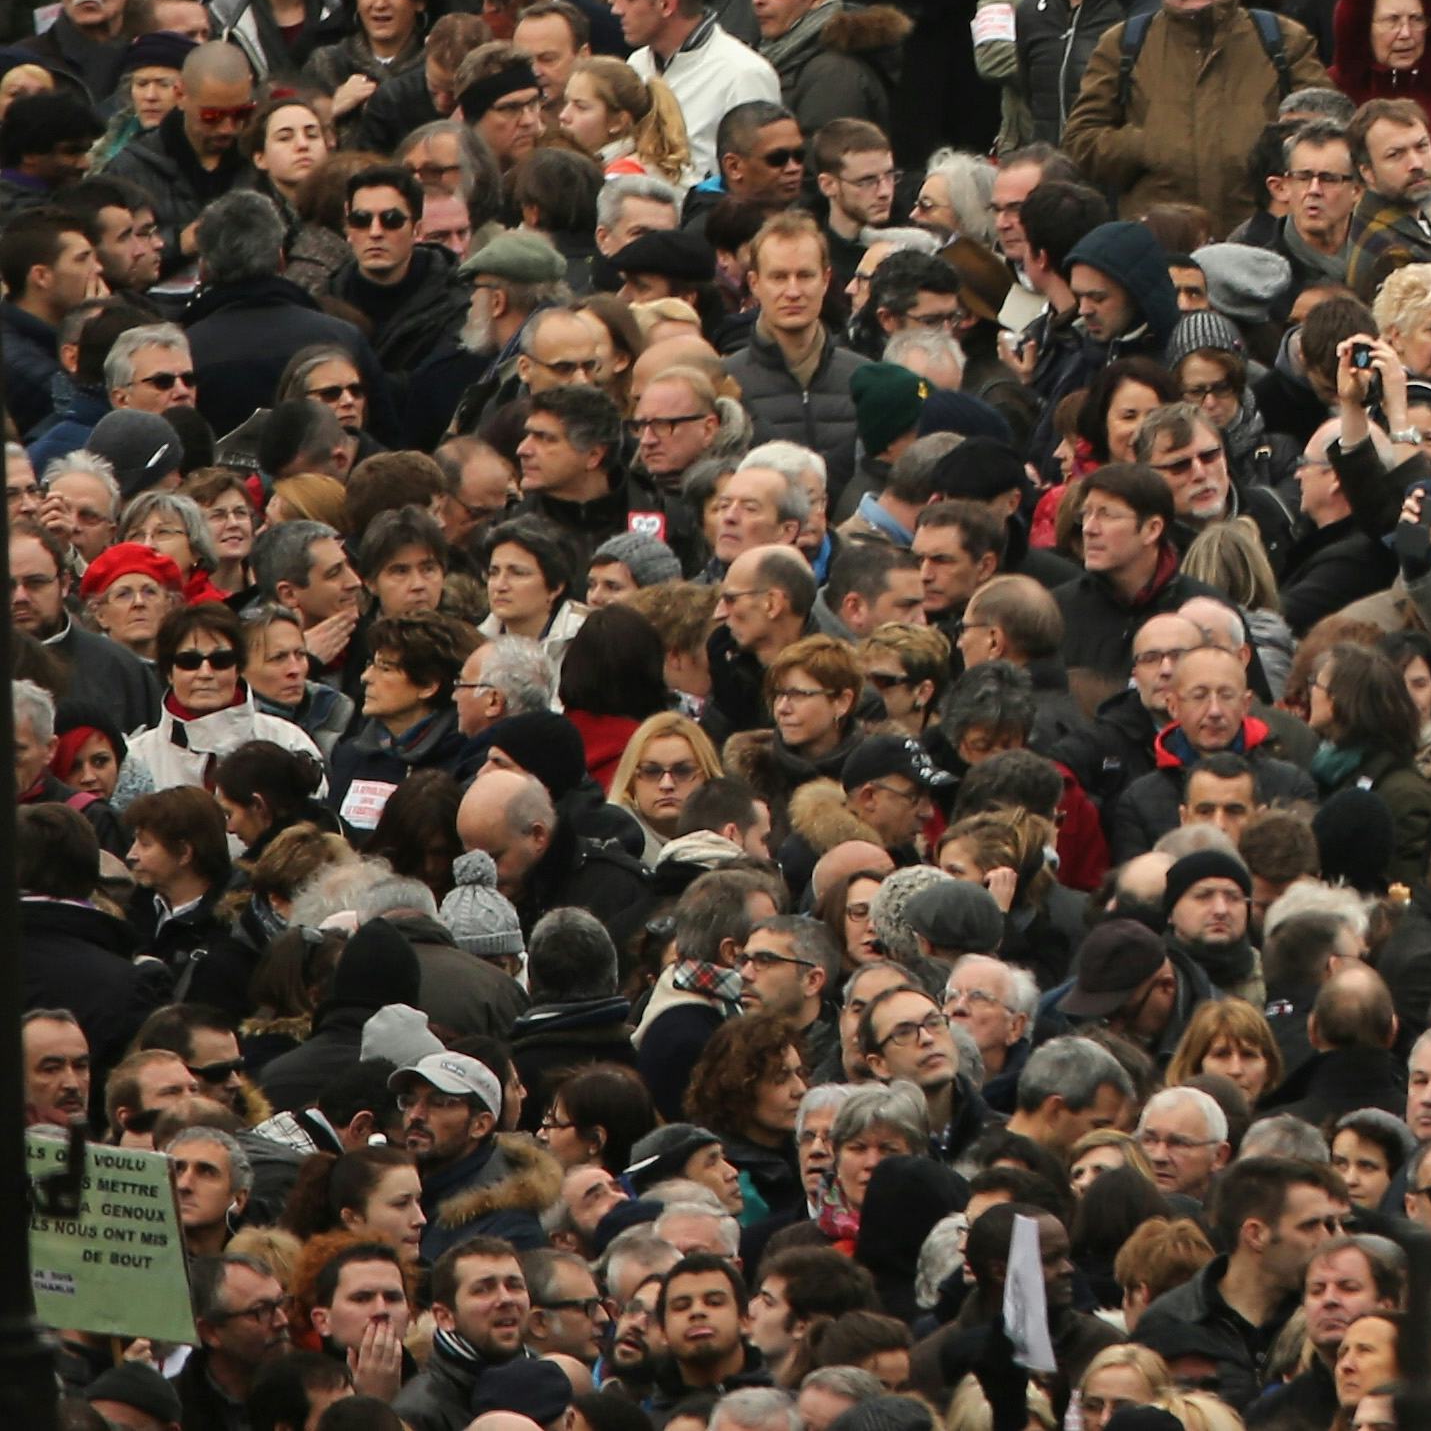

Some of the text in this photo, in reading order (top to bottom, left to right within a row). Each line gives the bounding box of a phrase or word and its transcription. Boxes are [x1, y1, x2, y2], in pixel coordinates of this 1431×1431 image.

[27, 1145, 46, 1160] LS
[94, 1154, 147, 1172] VOULU
[97, 1178, 160, 1198] METTRE
[102, 1203, 166, 1223] GENOUX
[31, 1217, 168, 1246] LS NOUS ONT MIS
[83, 1249, 153, 1269] DE BOUT
[51, 1271, 73, 1281] SUIS
[34, 1282, 75, 1294] CHARLIE
